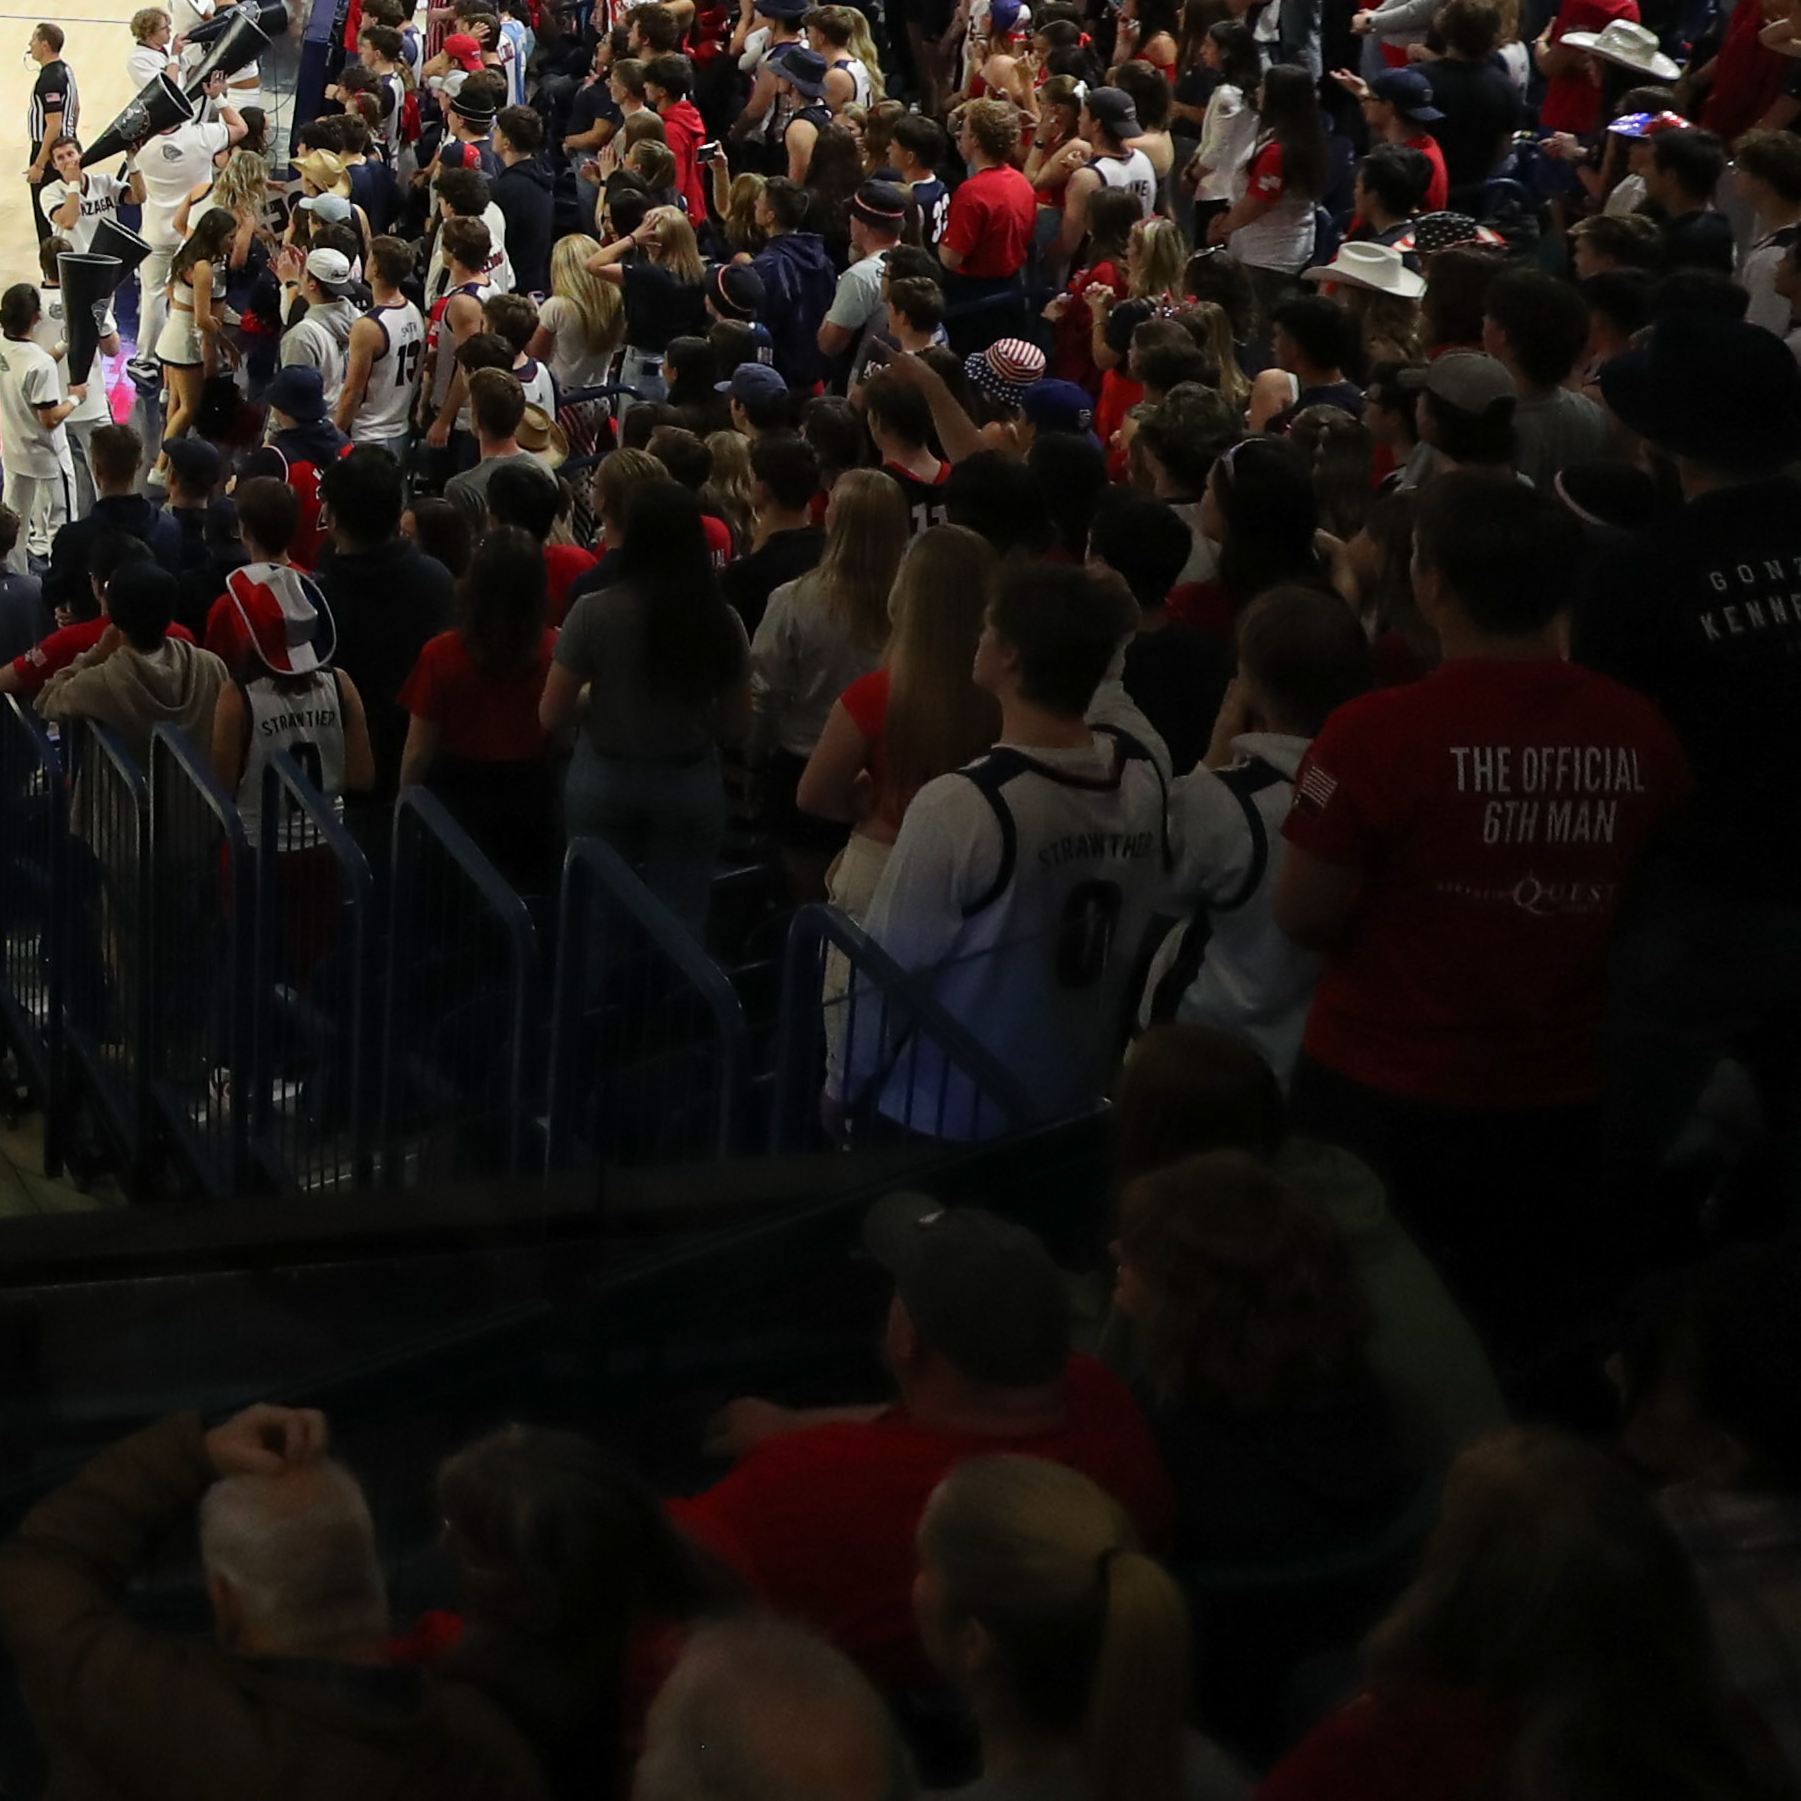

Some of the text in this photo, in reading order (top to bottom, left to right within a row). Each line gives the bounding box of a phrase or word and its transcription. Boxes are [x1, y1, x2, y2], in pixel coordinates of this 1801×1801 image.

[1449, 745, 1646, 794] THE OFFICIAL
[1483, 799, 1617, 845] 6TH MAN
[1057, 878, 1123, 988] 0
